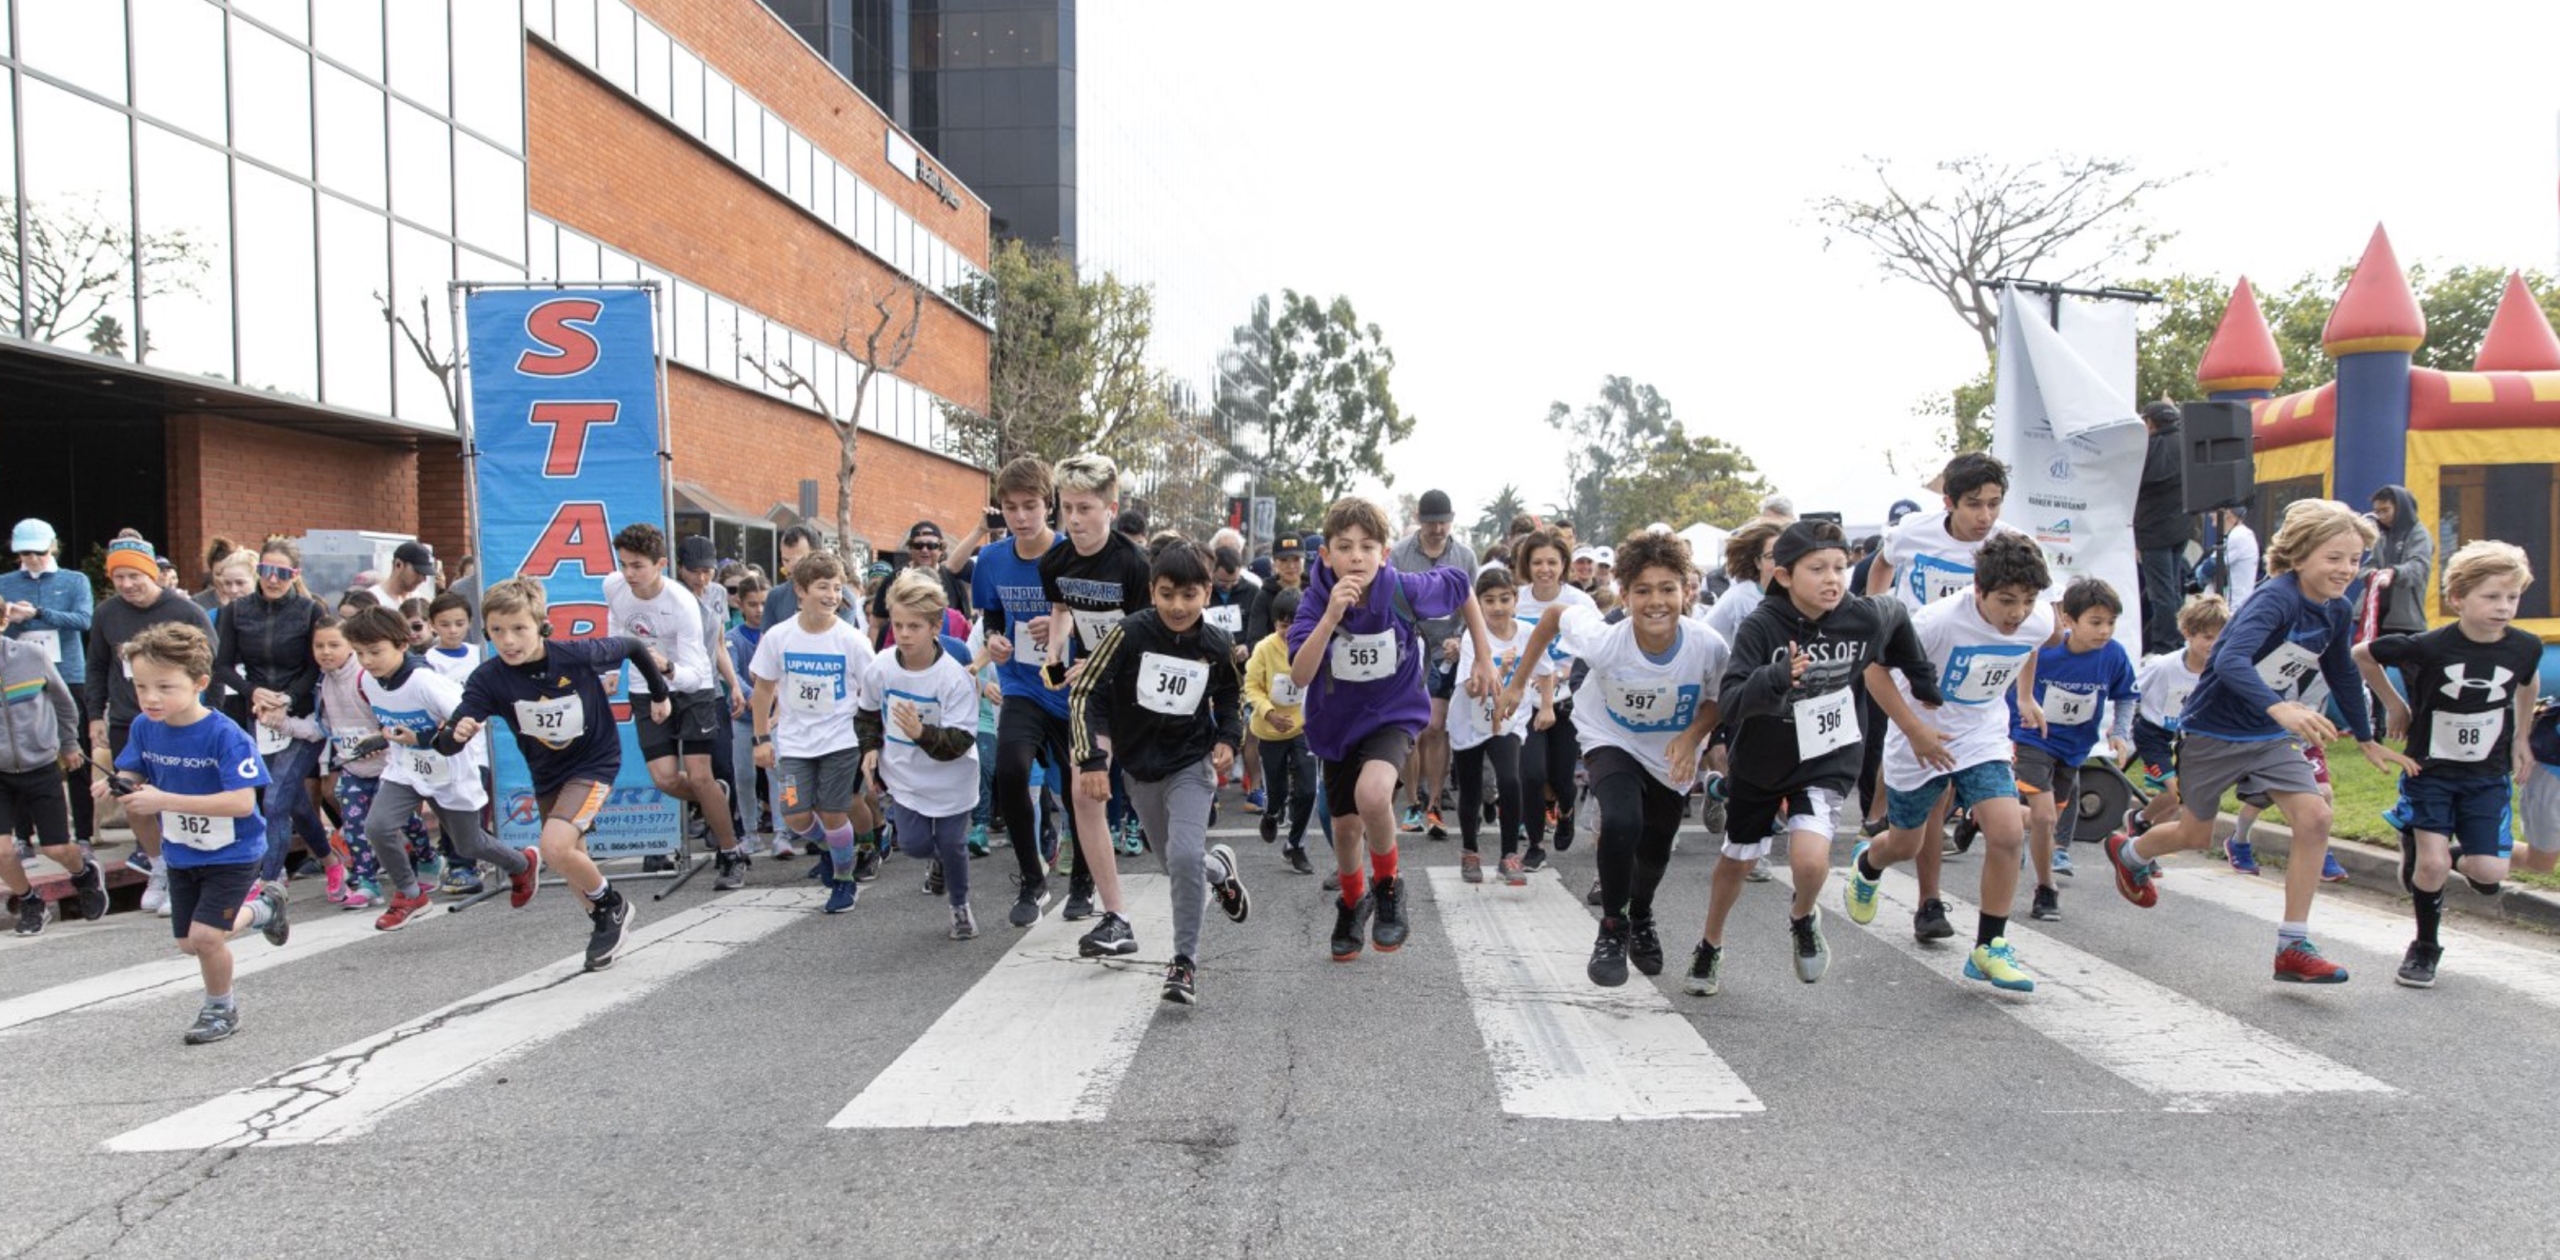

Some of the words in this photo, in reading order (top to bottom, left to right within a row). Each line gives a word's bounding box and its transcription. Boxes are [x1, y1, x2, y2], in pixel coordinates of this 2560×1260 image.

[1350, 648, 1378, 666] 563
[1771, 643, 1830, 664] CSS
[787, 660, 842, 671] UPWARD
[1156, 672, 1187, 696] 340
[1981, 669, 2011, 687] 195
[800, 685, 820, 701] 287
[1625, 694, 1656, 710] 597
[2062, 702, 2079, 715] 94
[535, 711, 564, 728] 327
[1817, 708, 1841, 735] 396
[2458, 728, 2480, 745] 88
[178, 815, 211, 834] 362
[622, 812, 677, 825] 433-5777
